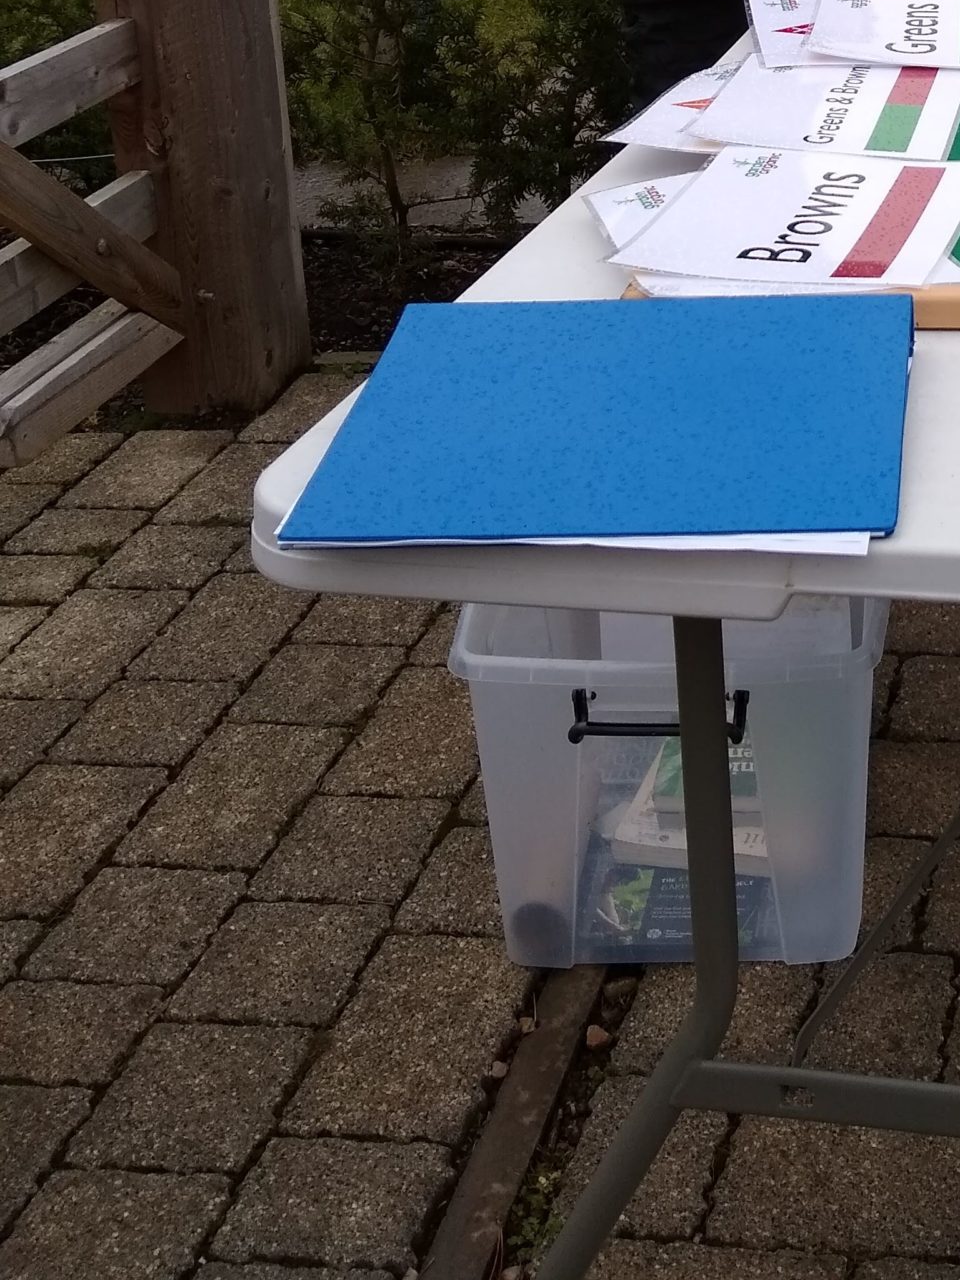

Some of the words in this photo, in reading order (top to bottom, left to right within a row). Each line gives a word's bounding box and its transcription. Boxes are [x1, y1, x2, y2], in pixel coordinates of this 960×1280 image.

[884, 2, 940, 55] Greens
[829, 64, 872, 95] Brown
[825, 96, 855, 105] &
[803, 107, 849, 145] Greens
[744, 155, 769, 178] garden
[758, 152, 783, 176] organic
[736, 170, 867, 264] Browns
